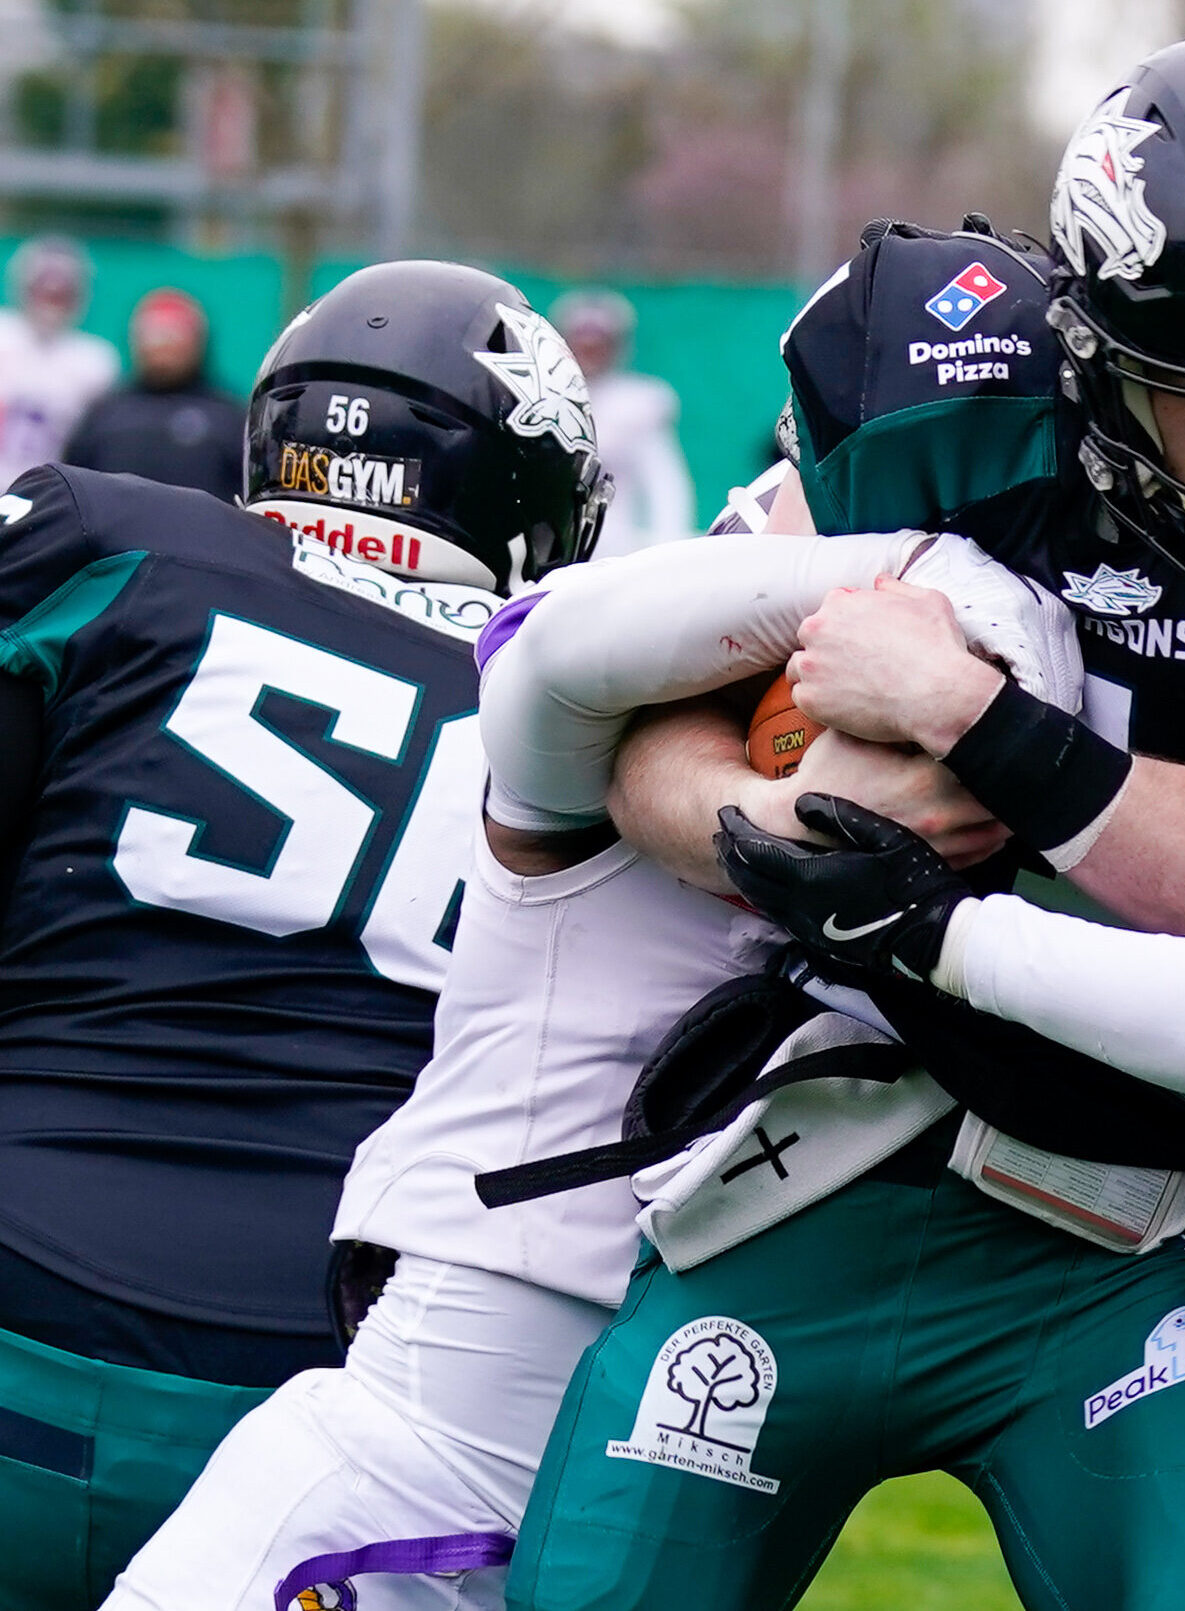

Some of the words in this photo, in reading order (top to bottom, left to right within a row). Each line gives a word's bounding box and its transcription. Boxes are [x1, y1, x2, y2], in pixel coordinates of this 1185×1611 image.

[908, 333, 1032, 365] Domino's
[937, 360, 1010, 386] Pizza
[325, 394, 371, 437] 56
[660, 1339, 681, 1363] DER
[684, 1320, 751, 1340] PERFEKTE
[750, 1338, 774, 1391] GARTEN
[611, 1443, 775, 1491] www.garten-miksch.com
